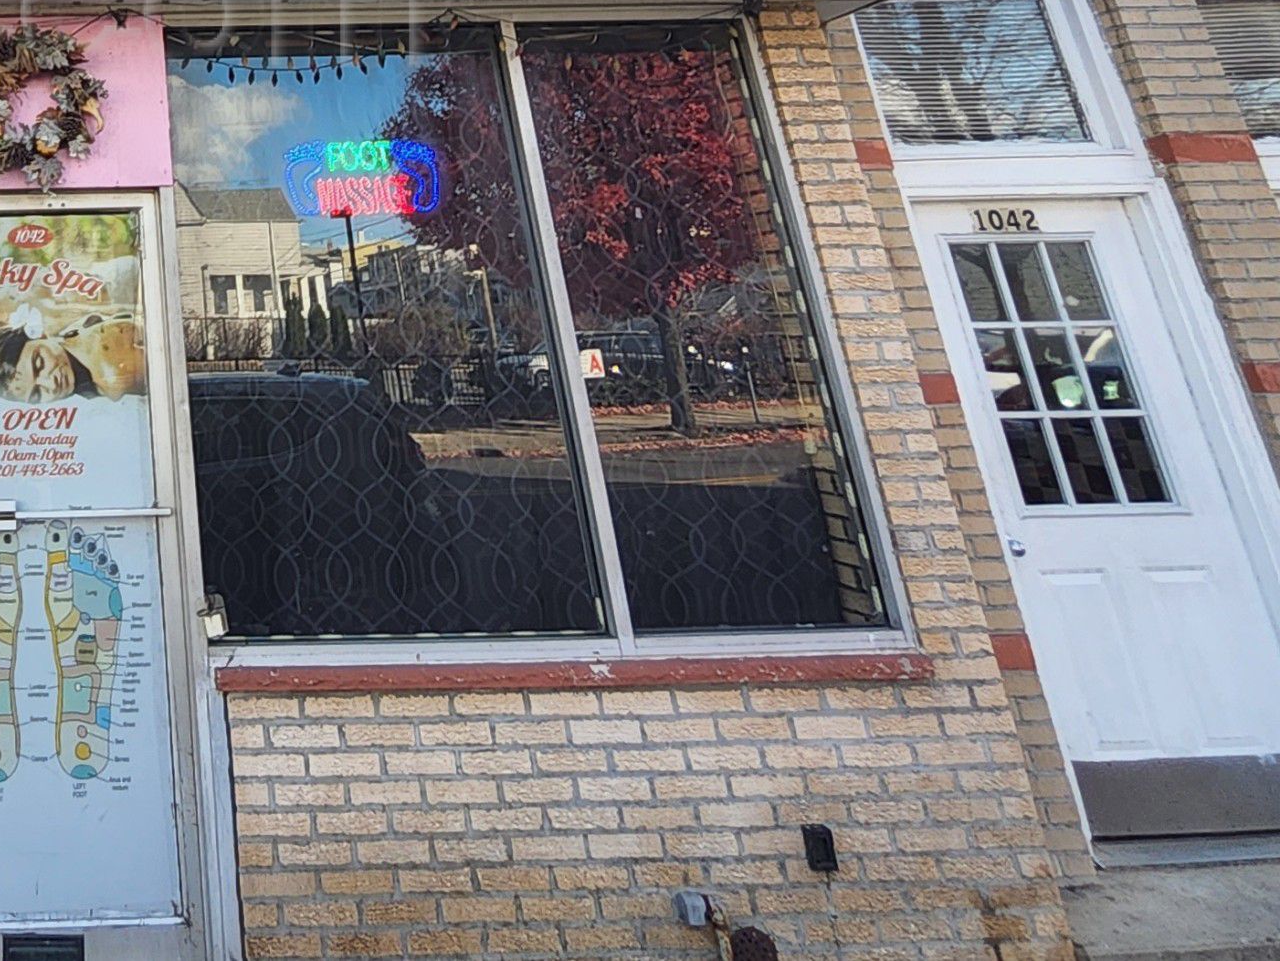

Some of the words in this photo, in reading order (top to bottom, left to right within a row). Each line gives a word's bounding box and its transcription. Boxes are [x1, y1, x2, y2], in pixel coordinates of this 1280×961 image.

[325, 140, 391, 172] FOOT
[316, 174, 415, 216] MASSAGE
[973, 209, 1039, 231] 1042
[14, 229, 46, 244] 1042
[42, 258, 104, 299] Spa
[2, 407, 79, 431] OPEN
[0, 448, 75, 463] 10am-10pm
